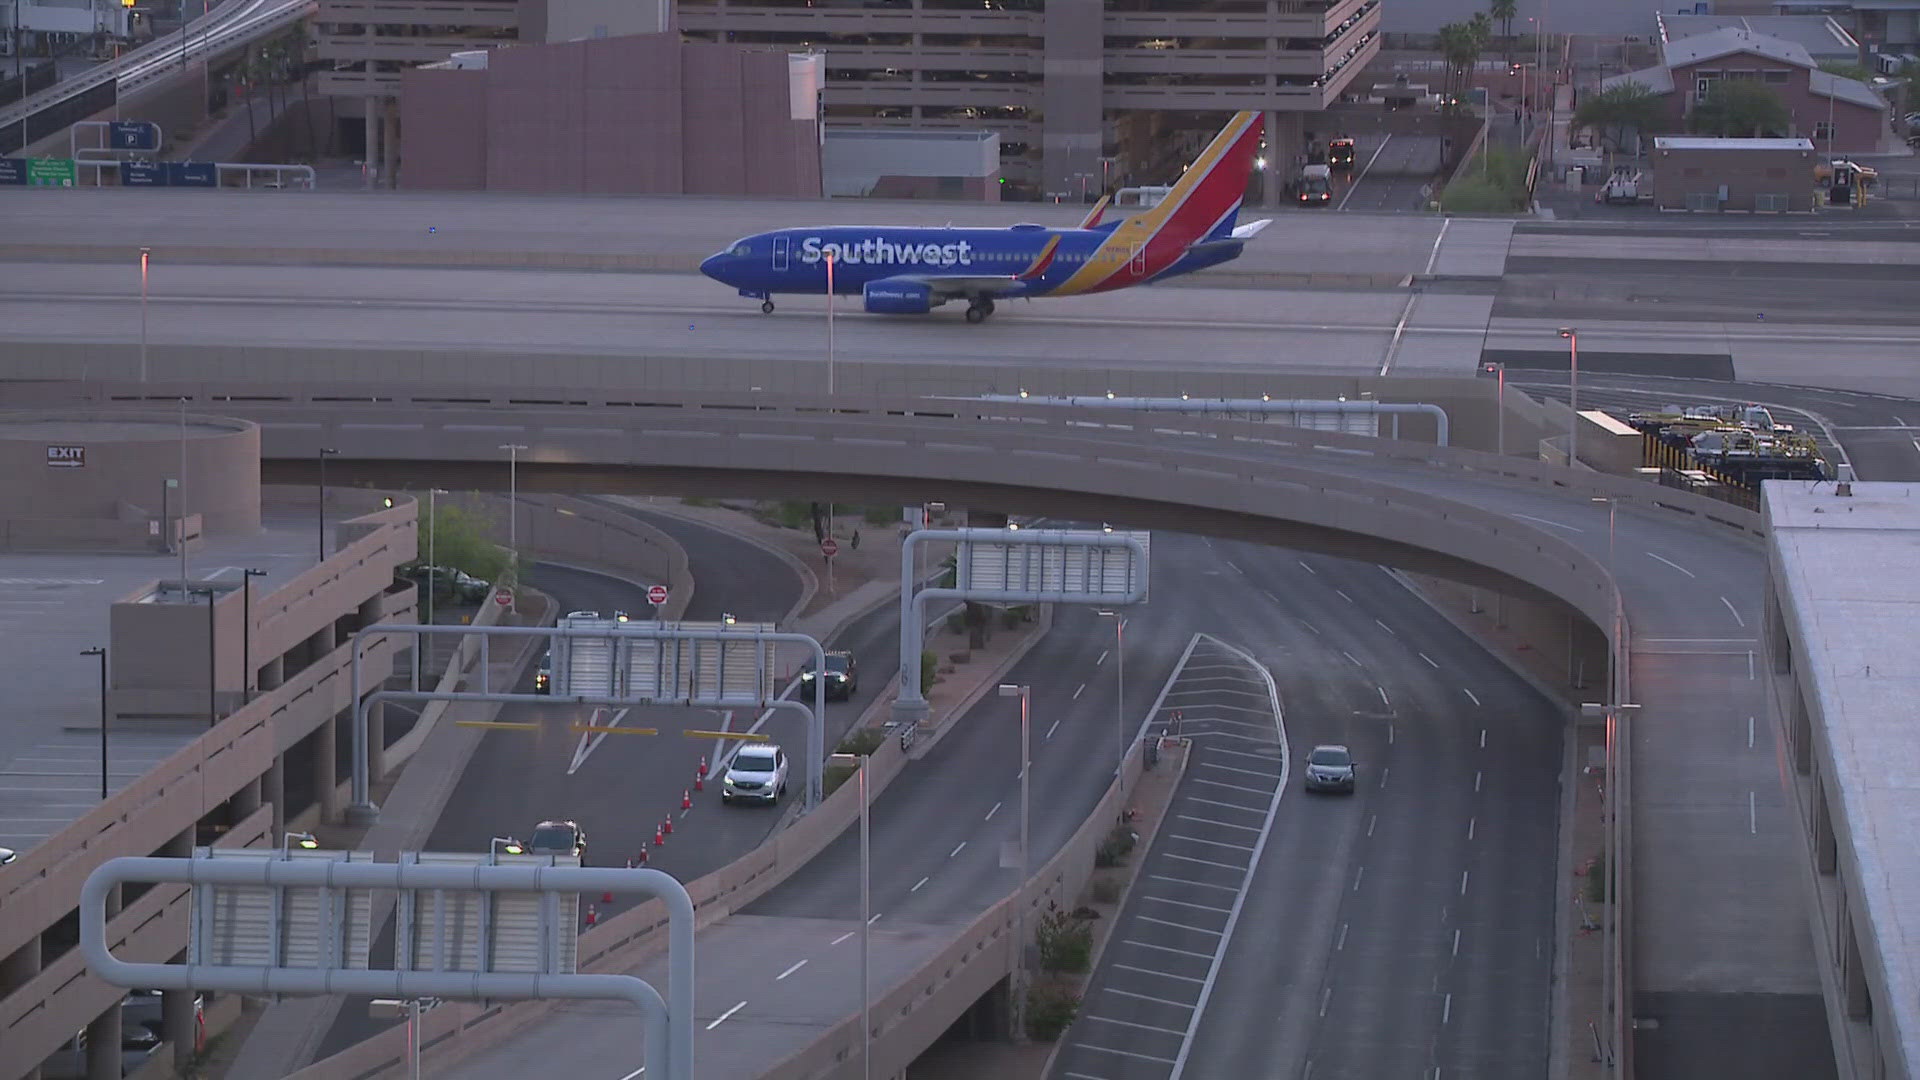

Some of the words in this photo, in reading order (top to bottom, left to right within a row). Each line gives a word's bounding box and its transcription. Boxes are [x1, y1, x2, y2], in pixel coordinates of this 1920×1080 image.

[127, 135, 135, 144] P
[802, 237, 972, 265] Southwest
[47, 447, 84, 458] EXIT
